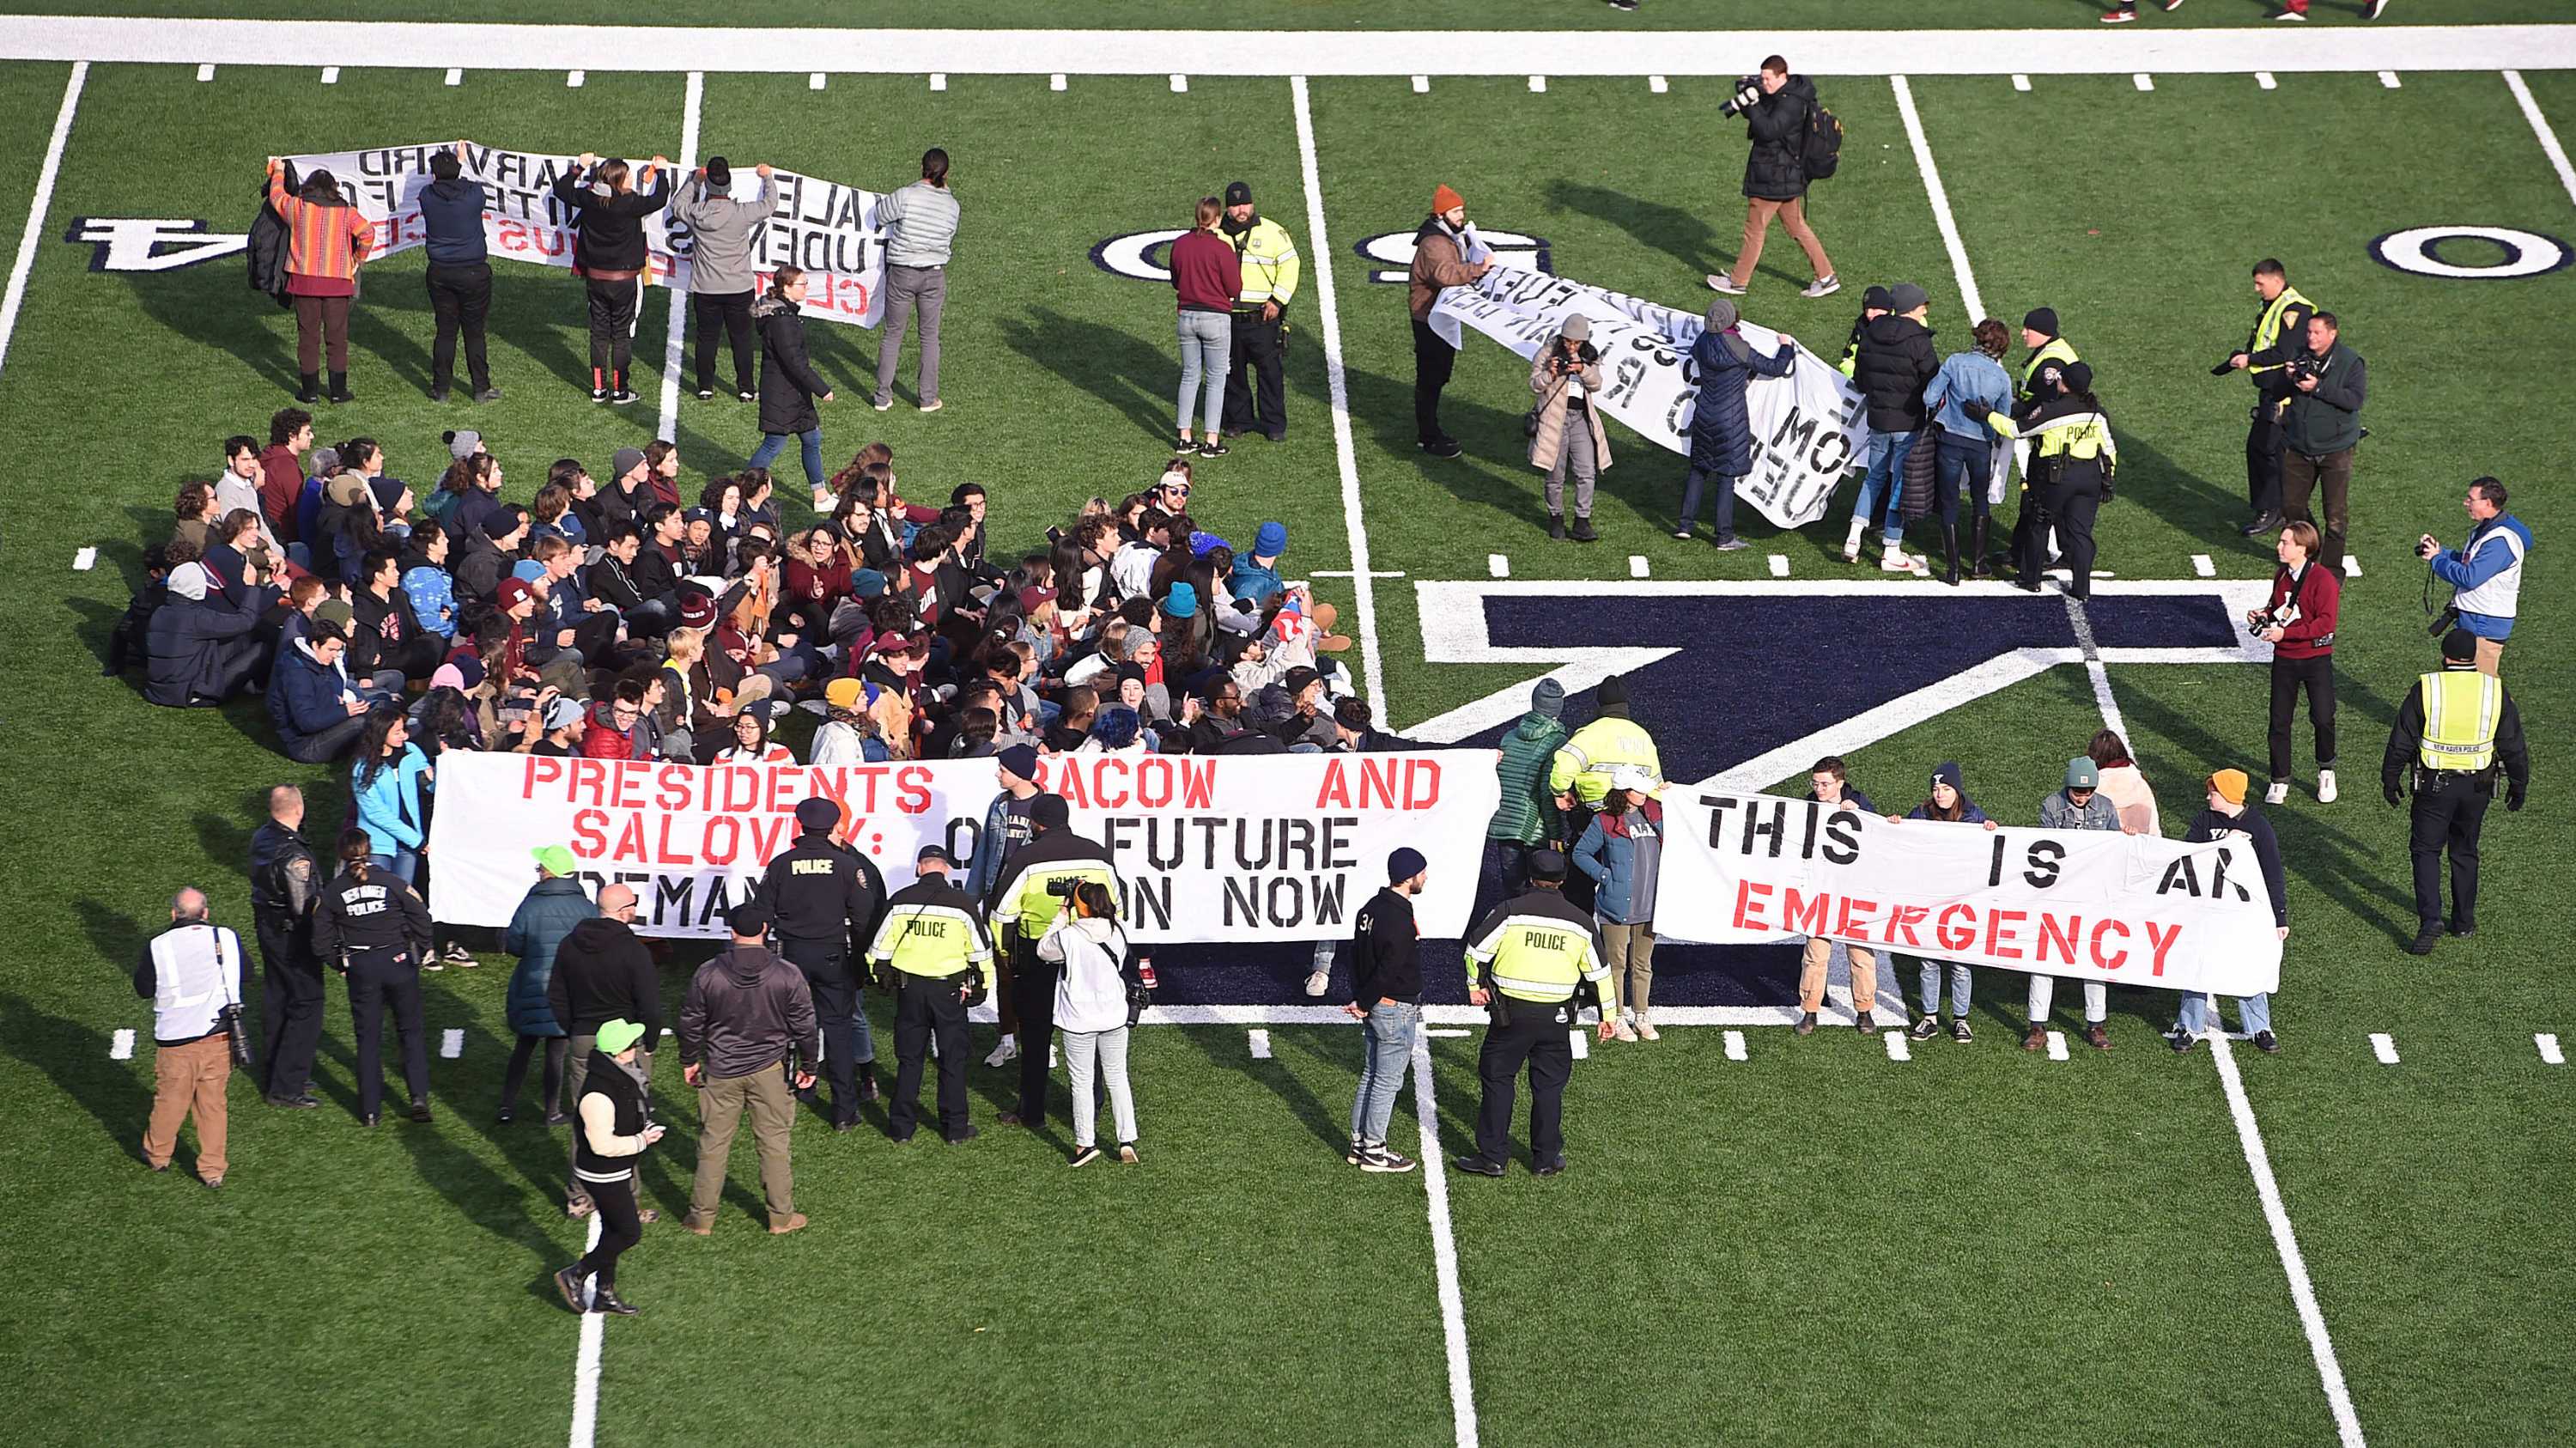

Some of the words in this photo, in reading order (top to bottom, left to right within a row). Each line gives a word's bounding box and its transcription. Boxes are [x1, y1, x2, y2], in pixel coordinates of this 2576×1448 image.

[522, 757, 934, 814] PRESIDENTS
[1315, 758, 1440, 811] AND
[791, 859, 834, 876] POLICE
[1104, 817, 1358, 871] FUTURE
[1699, 794, 1863, 865] THIS
[1989, 835, 2066, 889] IS
[1224, 873, 1346, 928] NOW
[1732, 879, 2184, 976] EMERGENCY
[907, 920, 947, 938] POLICE
[1524, 931, 1567, 952] POLICE
